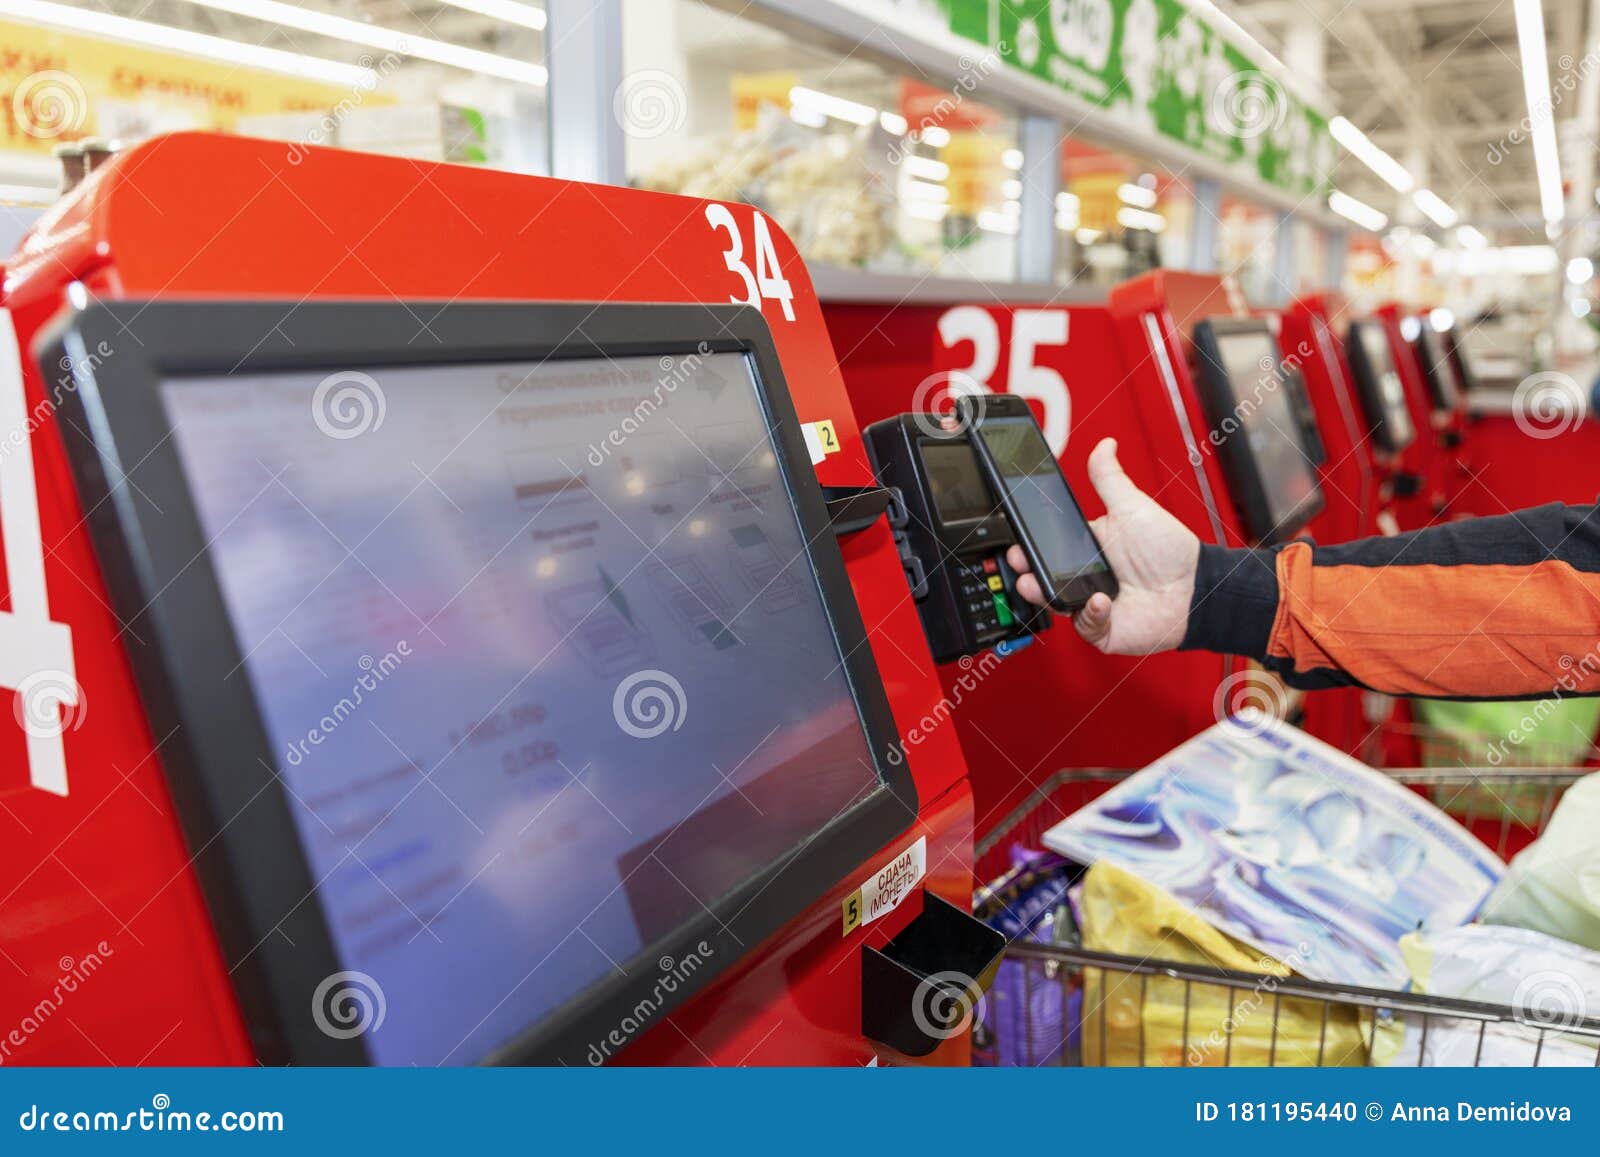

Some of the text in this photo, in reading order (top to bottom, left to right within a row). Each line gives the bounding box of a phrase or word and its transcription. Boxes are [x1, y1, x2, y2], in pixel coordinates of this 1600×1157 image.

[705, 203, 796, 322] 34
[937, 305, 1072, 460] 35
[822, 425, 834, 447] 2
[870, 864, 919, 918] (МОНЕТЫ)
[878, 853, 911, 890] СДАЧА
[848, 898, 858, 925] 5
